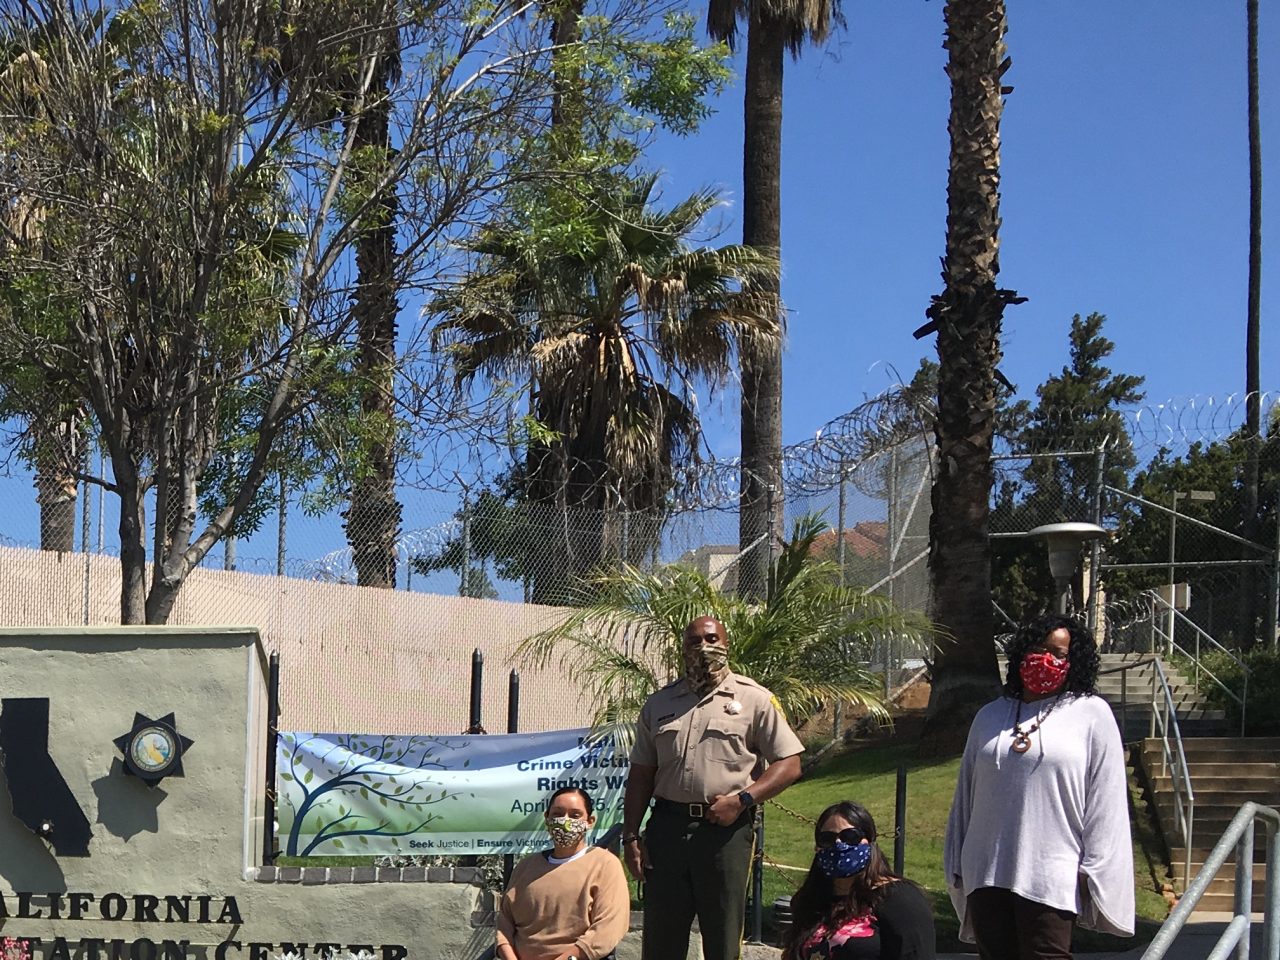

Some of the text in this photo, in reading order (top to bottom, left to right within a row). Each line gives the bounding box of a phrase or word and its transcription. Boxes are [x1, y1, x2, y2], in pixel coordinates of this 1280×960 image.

[517, 759, 573, 771] Crime
[537, 776, 598, 791] Rights
[409, 839, 434, 848] Seek
[436, 839, 469, 848] Justice
[477, 839, 513, 848] Ensure
